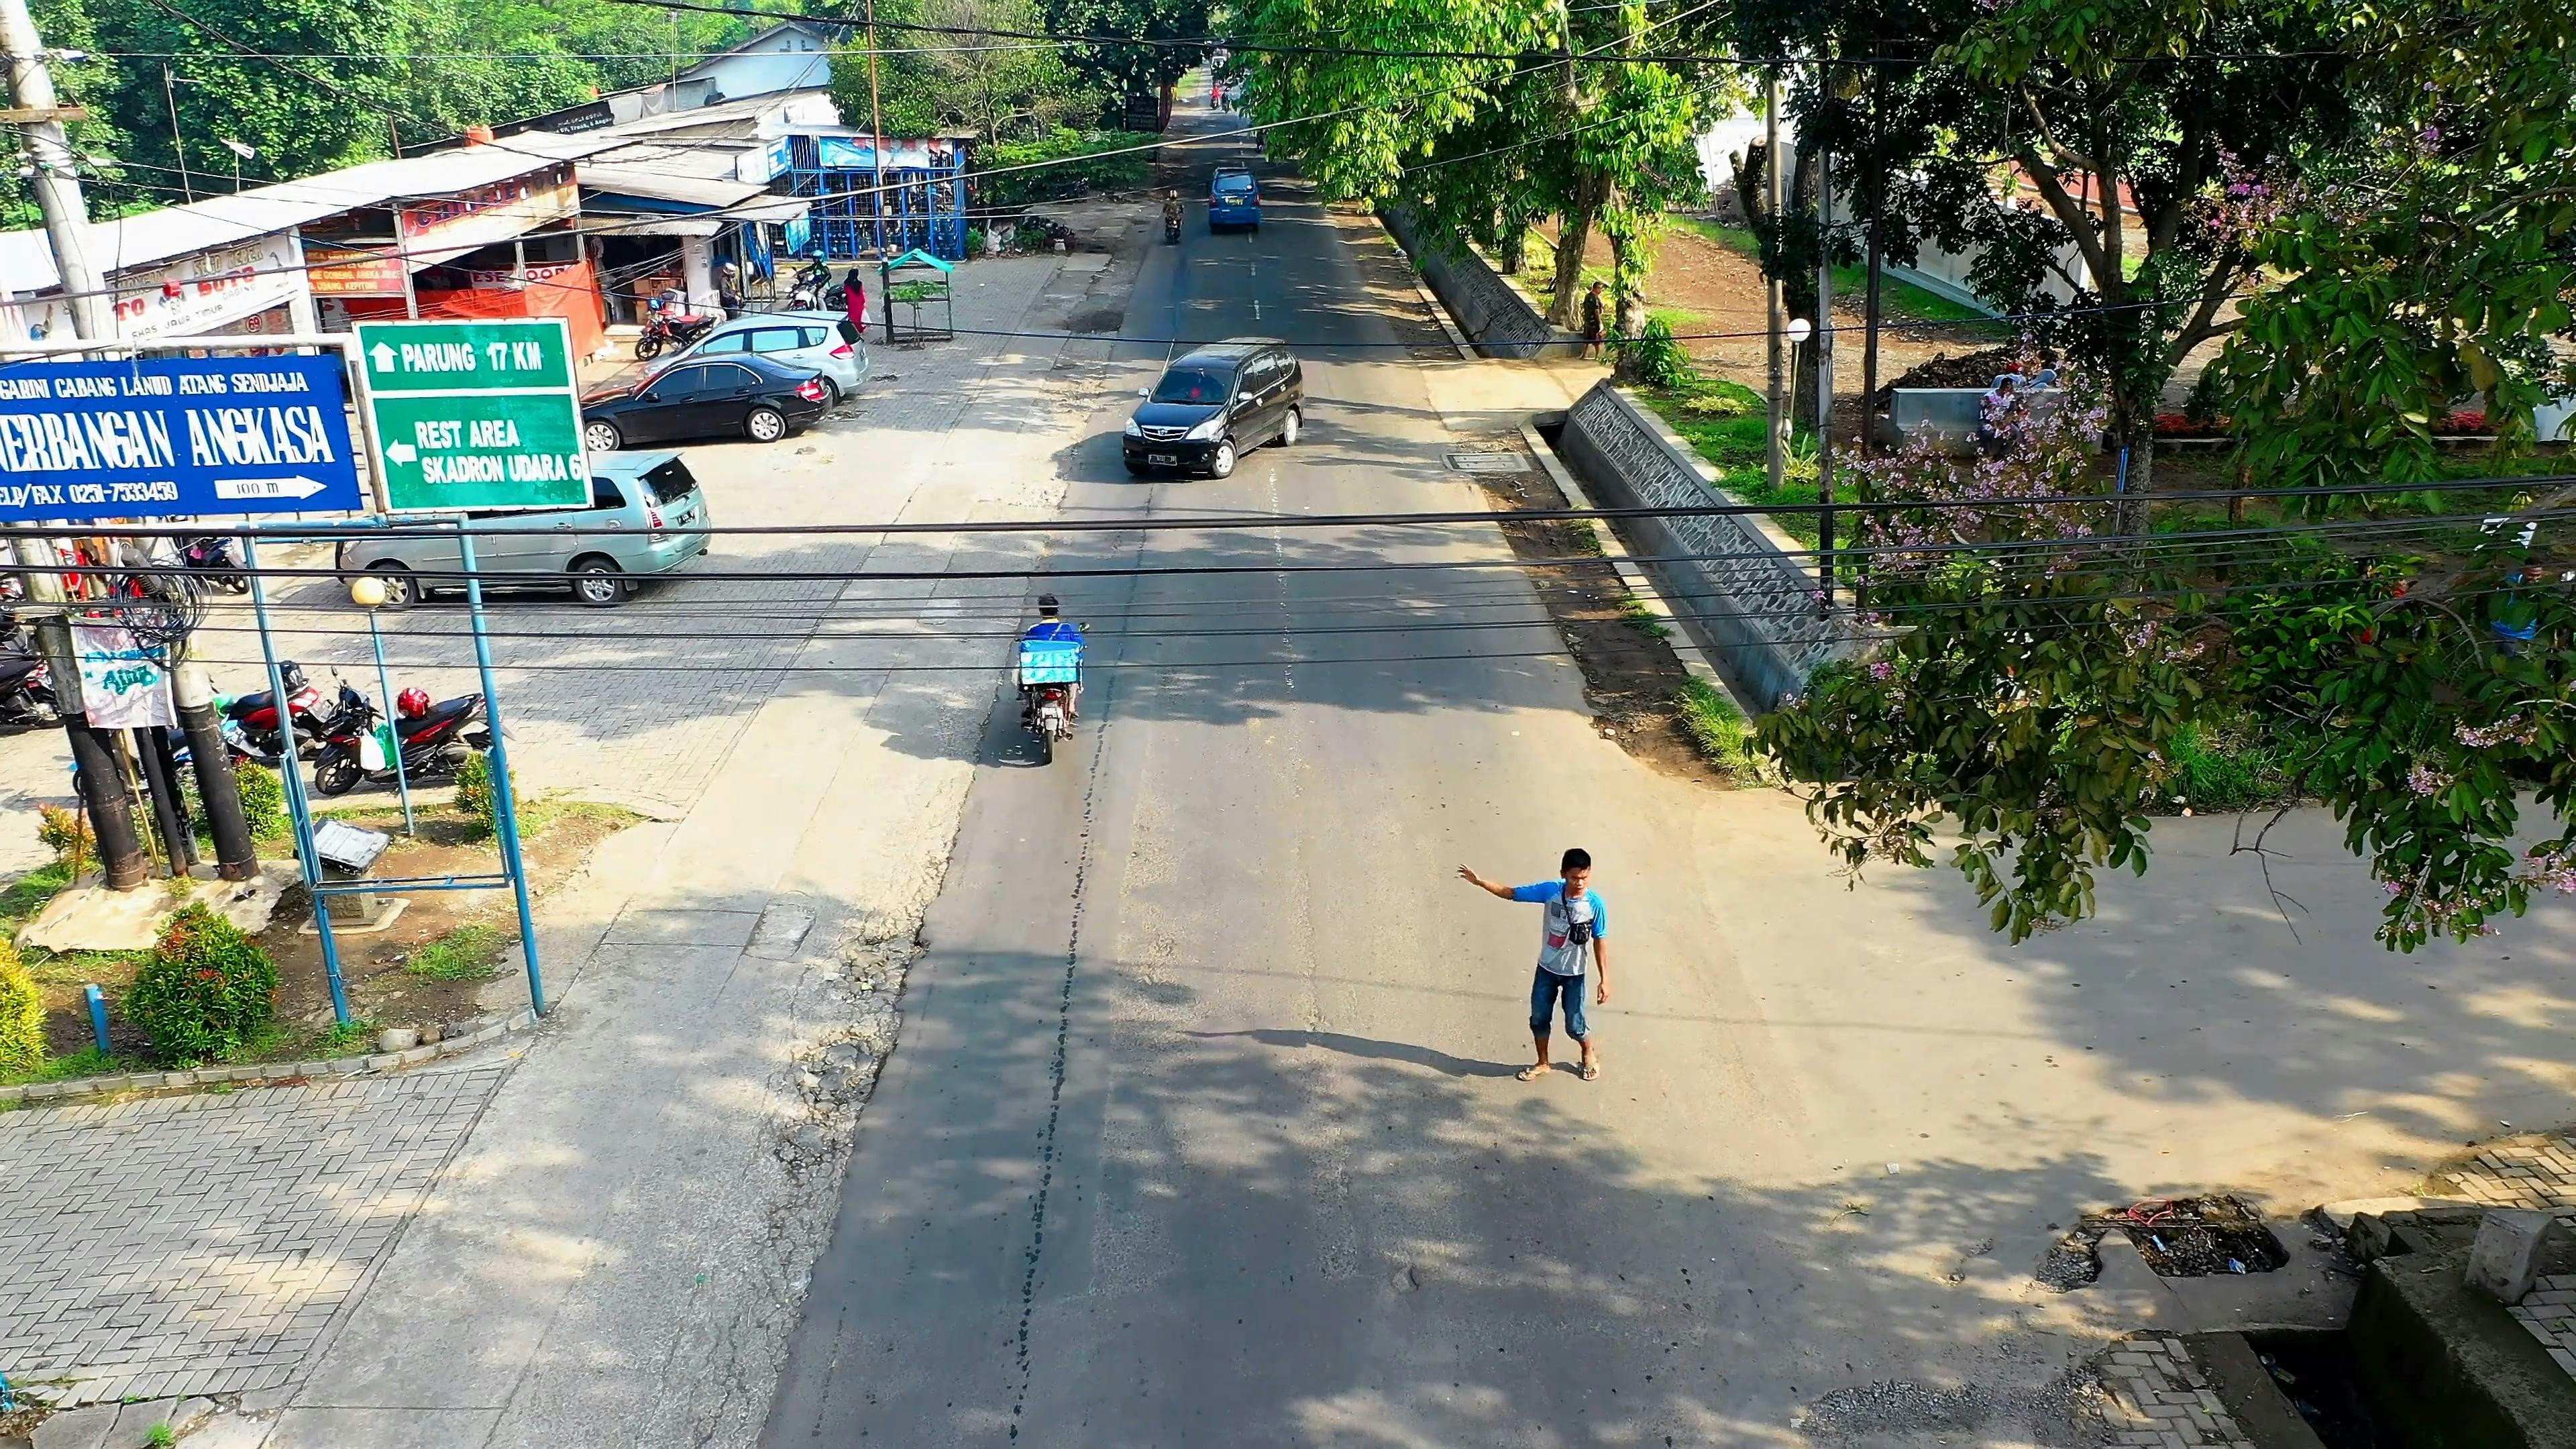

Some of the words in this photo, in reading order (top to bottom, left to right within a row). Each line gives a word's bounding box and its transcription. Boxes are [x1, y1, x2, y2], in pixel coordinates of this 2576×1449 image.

[400, 343, 476, 372] PARUNG
[486, 342, 508, 370] 17
[512, 341, 543, 370] KM
[55, 377, 117, 398] CABANG
[120, 376, 172, 396] LANUD
[179, 374, 227, 394] ATANG
[231, 372, 309, 393] SENDJAJA
[184, 405, 336, 466] ANGKASA
[414, 420, 462, 449] REST
[470, 419, 521, 448] AREA
[421, 454, 504, 484] SKADRON
[507, 453, 568, 482] UDARA
[68, 481, 178, 504] 0251-7533459
[237, 483, 260, 494] 100
